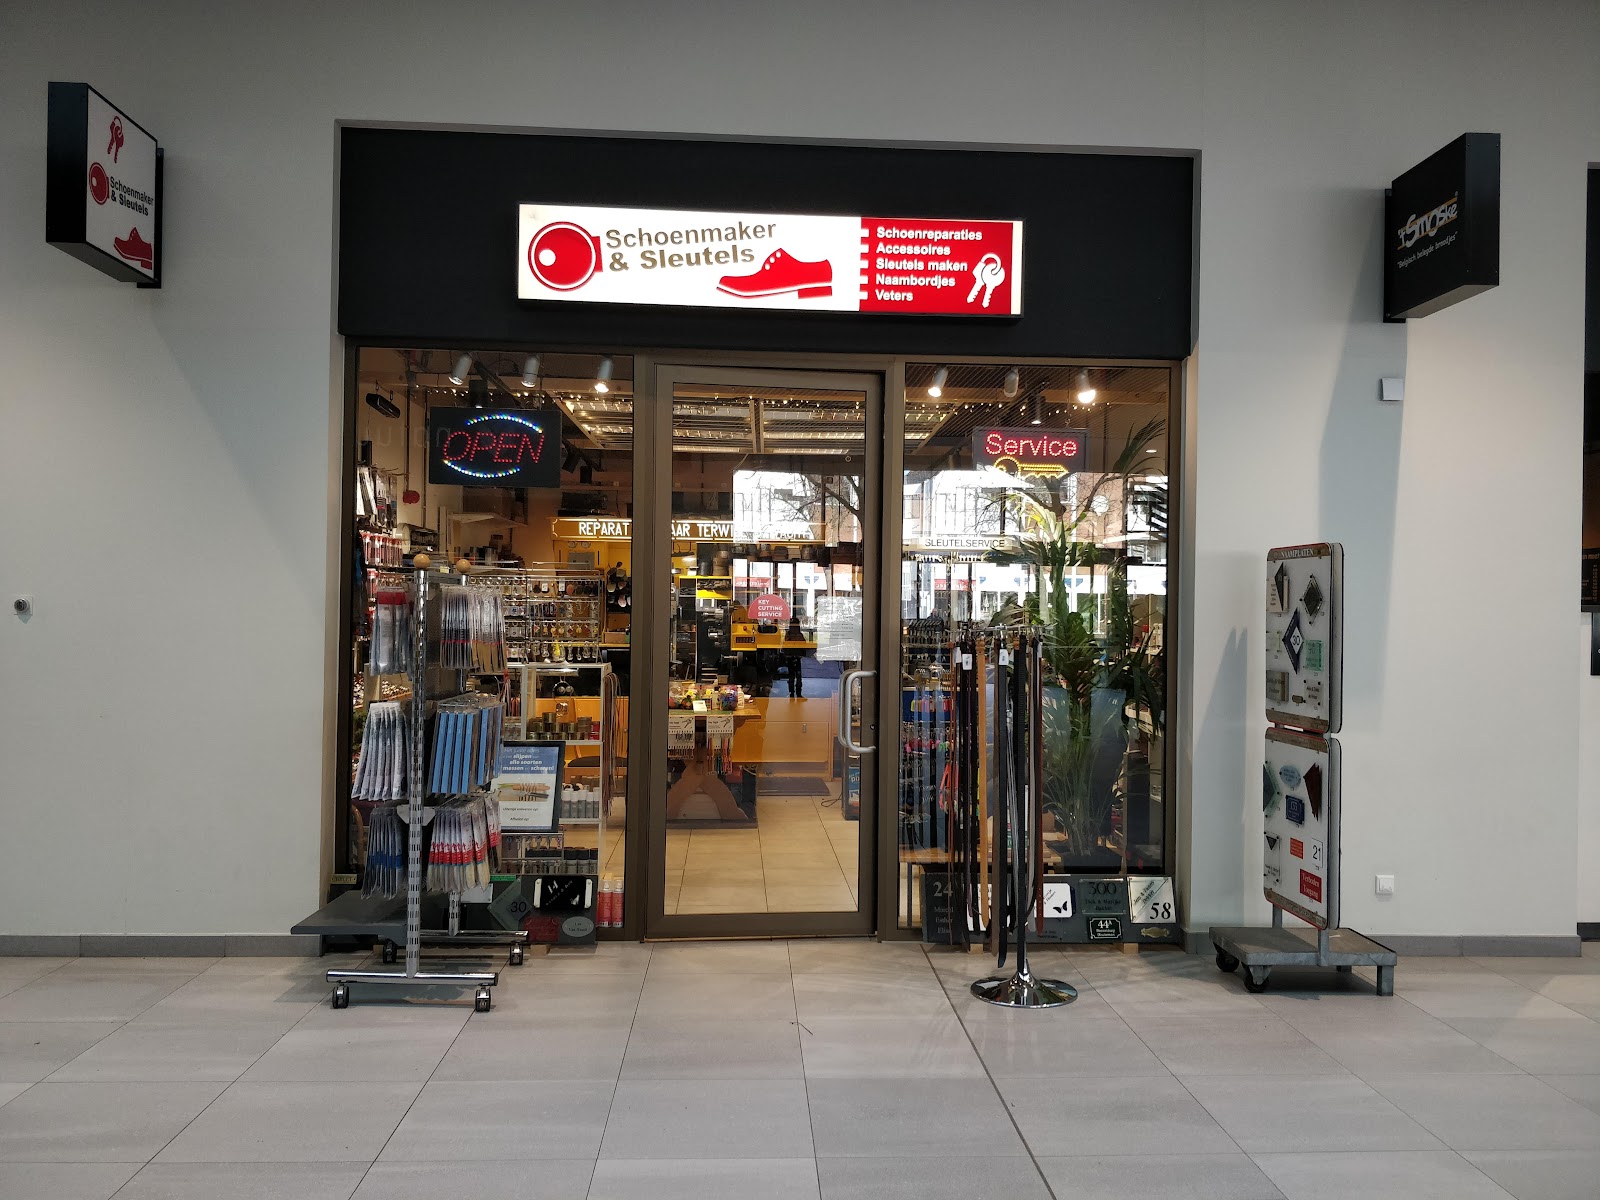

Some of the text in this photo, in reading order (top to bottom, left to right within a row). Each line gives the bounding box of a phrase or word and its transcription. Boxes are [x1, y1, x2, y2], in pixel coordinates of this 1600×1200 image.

[110, 176, 154, 206] Schoenmaker
[111, 189, 149, 216] & Sleutels
[605, 221, 777, 249] Schoenmaker
[876, 226, 983, 242] Schoenreparaties
[876, 242, 951, 255] Accessoires
[609, 244, 755, 272] & Sleutels
[876, 257, 968, 271] Sleutels maken
[876, 273, 956, 289] Naambordjes
[875, 289, 914, 301] Veters
[443, 431, 545, 463] OPEN
[985, 432, 1078, 457] Service
[578, 522, 630, 536] REPARAT
[925, 538, 1005, 548] SLEUTELSERVICE
[1291, 635, 1300, 646] 30
[932, 881, 954, 897] 24
[1088, 881, 1117, 895] 300
[510, 901, 527, 913] 30
[1149, 902, 1172, 920] 58
